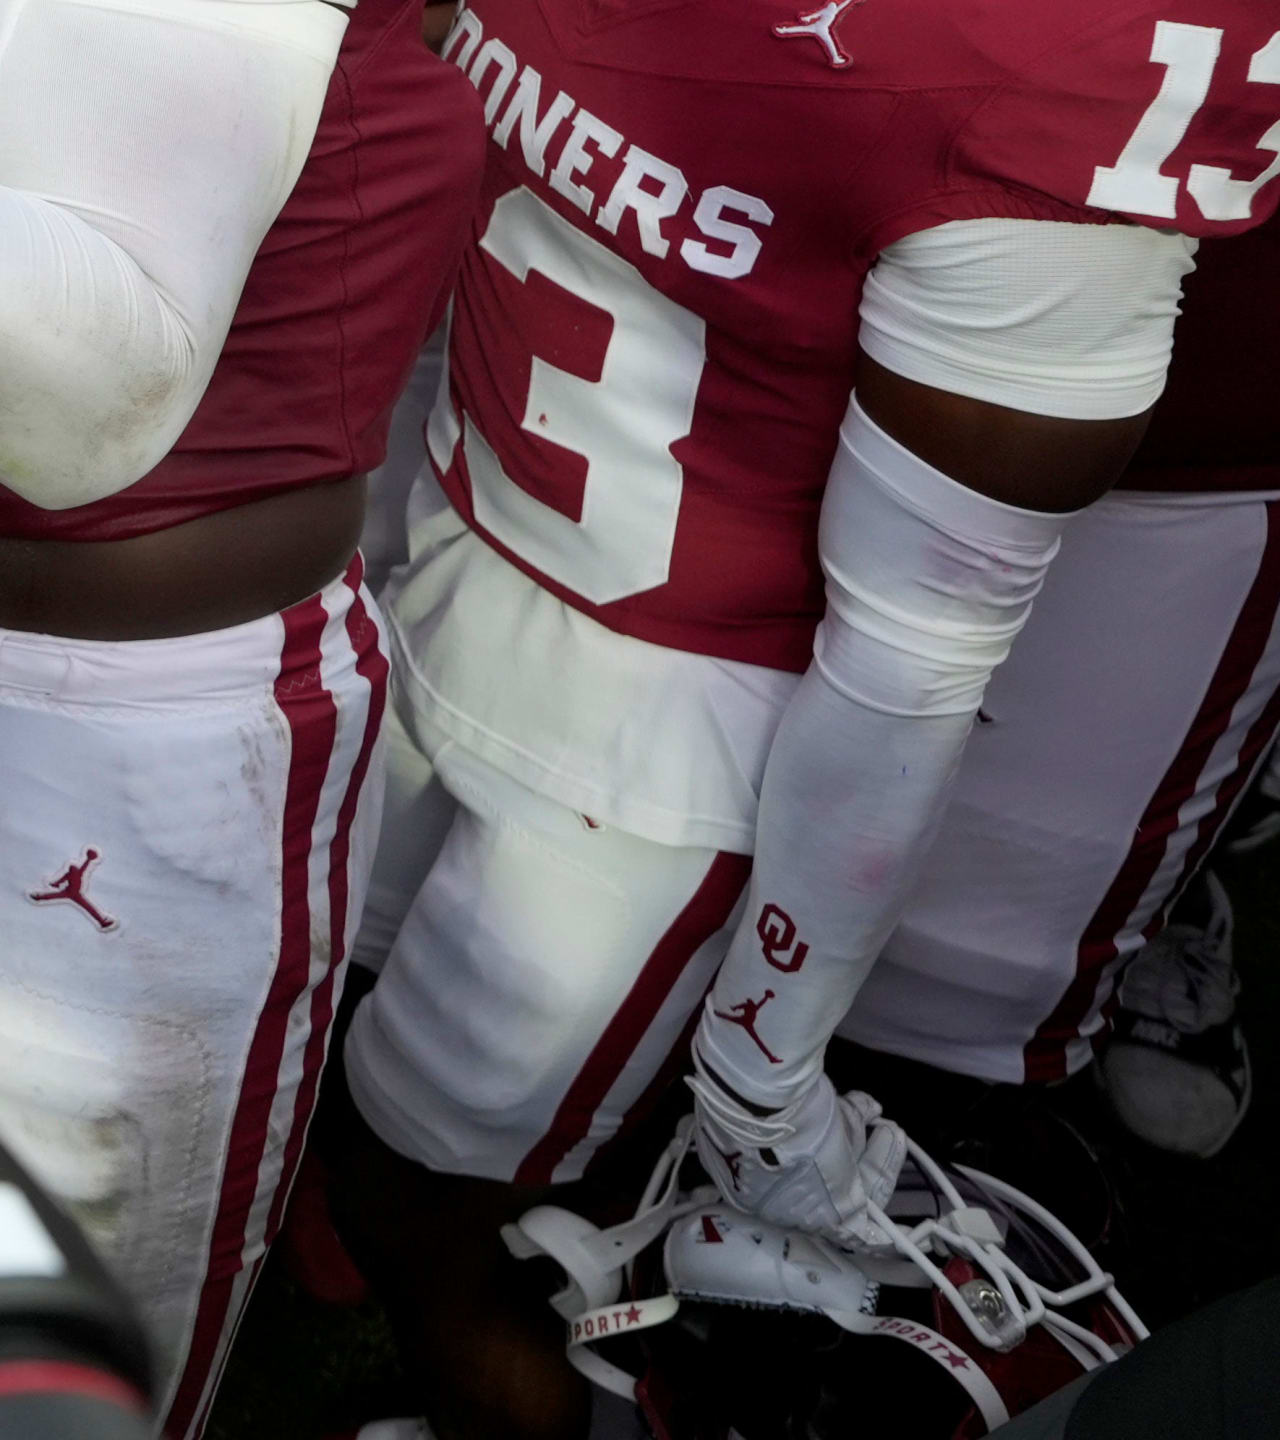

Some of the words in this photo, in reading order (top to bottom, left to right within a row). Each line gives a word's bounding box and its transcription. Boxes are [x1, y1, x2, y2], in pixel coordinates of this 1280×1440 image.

[442, 7, 775, 280] OONERS
[425, 183, 708, 606] 3
[756, 902, 810, 973] OU
